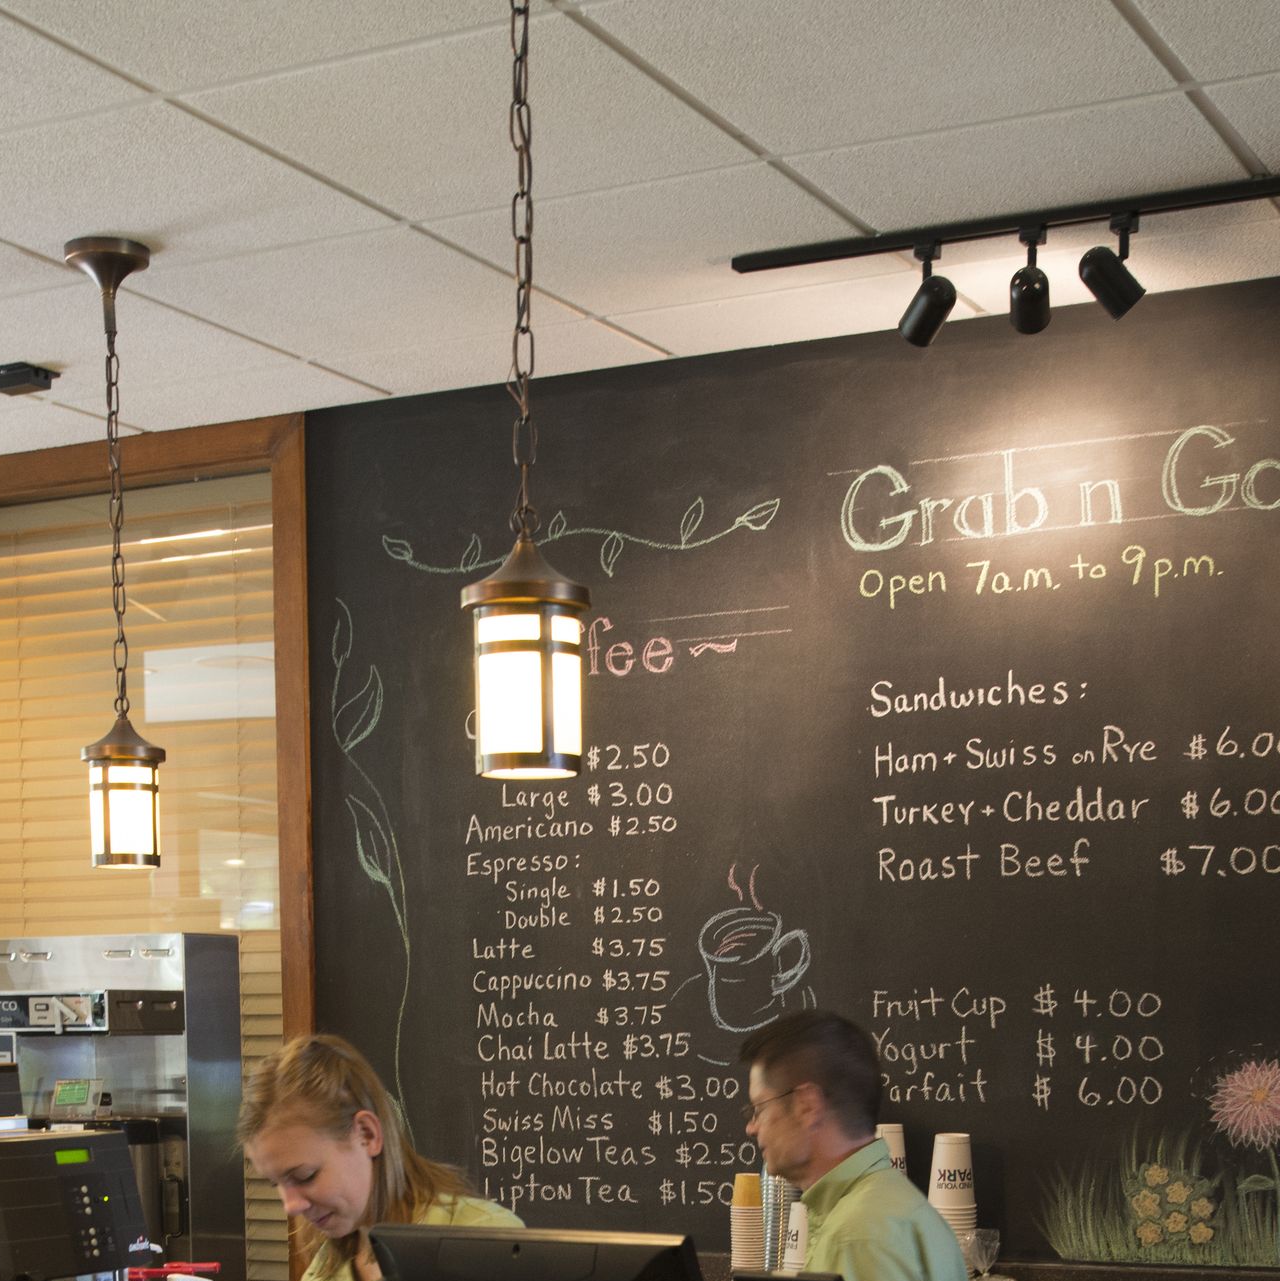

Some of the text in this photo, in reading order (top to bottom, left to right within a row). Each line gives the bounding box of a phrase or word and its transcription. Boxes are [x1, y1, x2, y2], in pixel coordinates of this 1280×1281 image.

[840, 448, 1048, 551] Grab
[1079, 478, 1122, 527] n
[860, 568, 947, 610] Open
[966, 560, 1061, 595] 7a.m.
[1069, 553, 1107, 581] to
[868, 669, 1088, 718] Sandwiches:
[587, 743, 670, 771] $2.50
[965, 738, 1057, 770] Swiss
[1072, 749, 1096, 765] on
[1102, 725, 1158, 764] Rye
[501, 782, 674, 820] Large $3.00
[1003, 785, 1150, 824] Cheddar
[465, 815, 678, 845] Americano $2.50
[466, 850, 581, 884] Espresso:
[878, 844, 981, 882] Roast
[1000, 837, 1090, 878] Beef
[504, 876, 661, 908] Single $1.50
[504, 905, 663, 930] Double $2.50
[472, 937, 666, 960] Latte $3.75
[472, 966, 670, 999] Cappuccino $3.75
[477, 1003, 667, 1029] Mocha $3.75
[872, 987, 944, 1022] Fruit
[951, 987, 1007, 1028] Cup
[477, 1030, 691, 1062] Chai Latte $3.75
[872, 1026, 976, 1075] Yogurt
[481, 1067, 739, 1102] Hot Chocolate $3.00
[482, 1105, 718, 1135] Swiss Miss $1.50
[482, 1136, 757, 1180] Bigelow Teas $2.50
[483, 1173, 734, 1212] Lipton Tea $1.50
